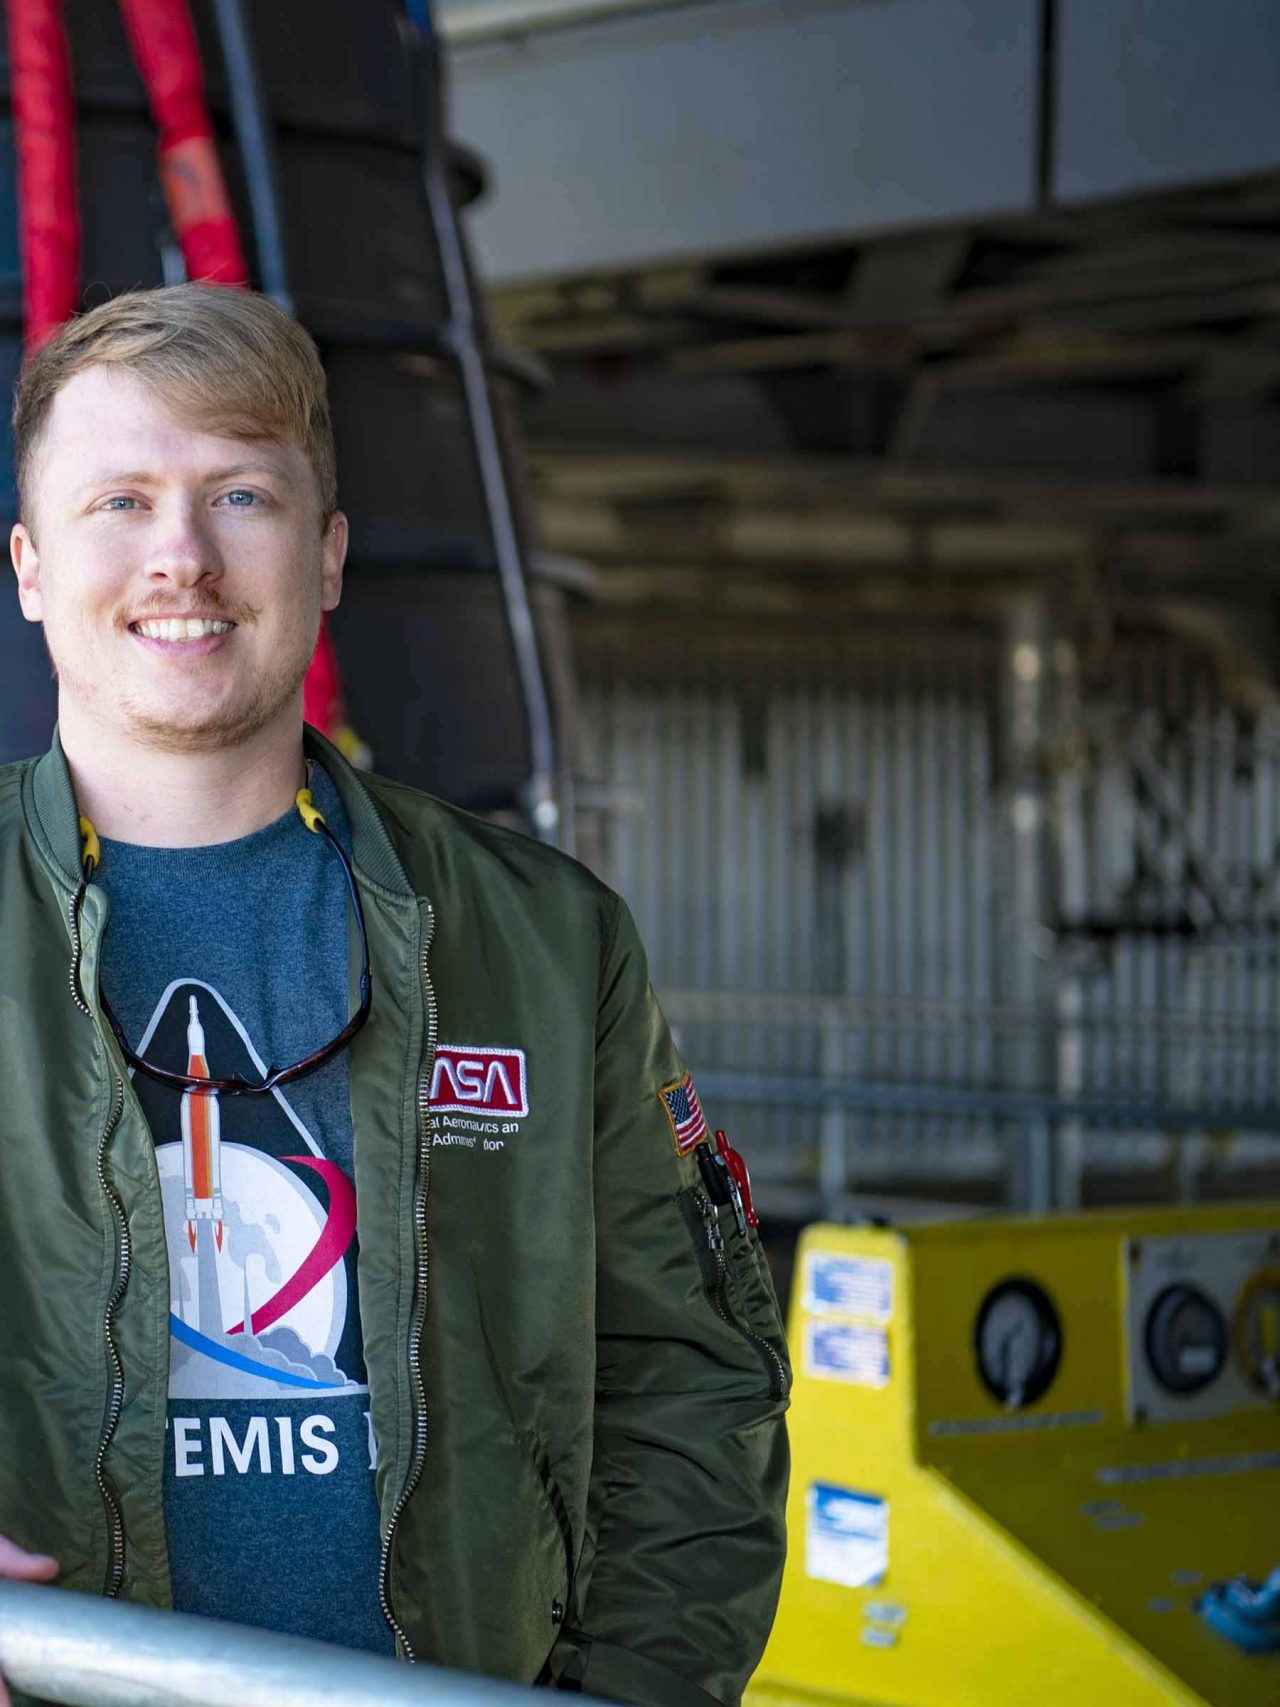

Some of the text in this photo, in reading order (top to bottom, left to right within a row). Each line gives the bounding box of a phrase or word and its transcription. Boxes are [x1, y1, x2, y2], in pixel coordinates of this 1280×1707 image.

[430, 1057, 518, 1105] ASA
[443, 1116, 499, 1133] Aeronauics
[502, 1123, 519, 1133] an
[166, 1414, 339, 1477] EMIS
